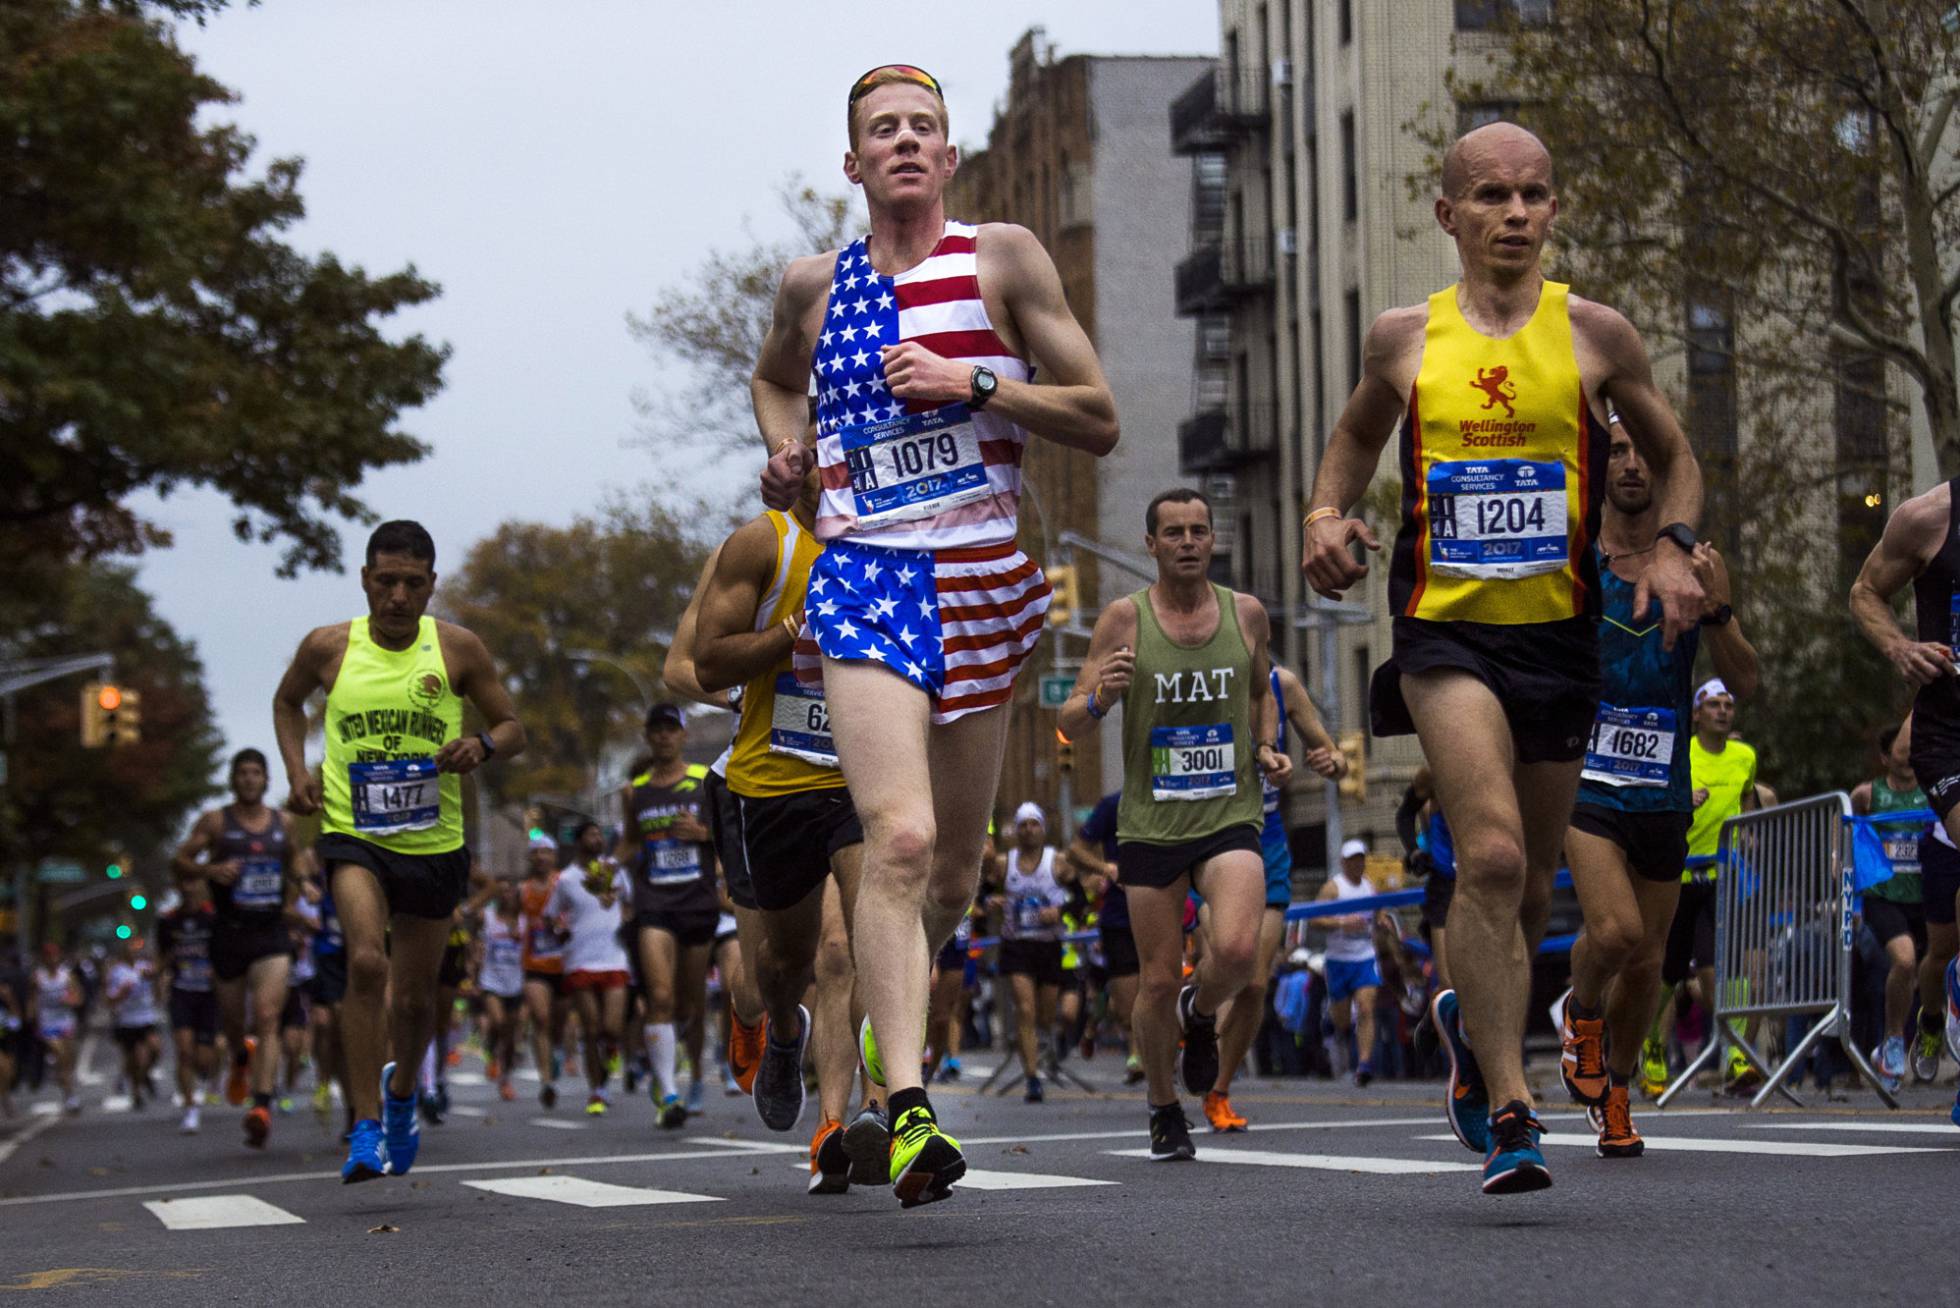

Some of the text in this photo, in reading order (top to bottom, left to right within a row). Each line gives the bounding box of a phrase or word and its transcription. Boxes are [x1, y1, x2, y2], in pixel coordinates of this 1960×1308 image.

[863, 419, 910, 435] CONSULTANCY
[921, 416, 944, 427] TATA
[1460, 420, 1536, 435] Wellington
[873, 427, 905, 441] SERVICES
[1462, 433, 1526, 447] Scottish
[891, 432, 959, 478] 1079
[1450, 473, 1504, 483] CONSULTANCY
[1465, 466, 1489, 474] TATA
[905, 478, 942, 498] 2017
[1460, 482, 1497, 491] SERVICES
[1514, 479, 1539, 487] TATA
[1477, 497, 1546, 535] 1204
[1482, 541, 1522, 556] 2017
[1154, 667, 1234, 704] MAT
[383, 735, 402, 751] OF
[1612, 729, 1660, 759] 1682
[1181, 748, 1223, 772] 3001
[383, 784, 424, 810] 1477
[1842, 871, 1854, 947] NYPD
